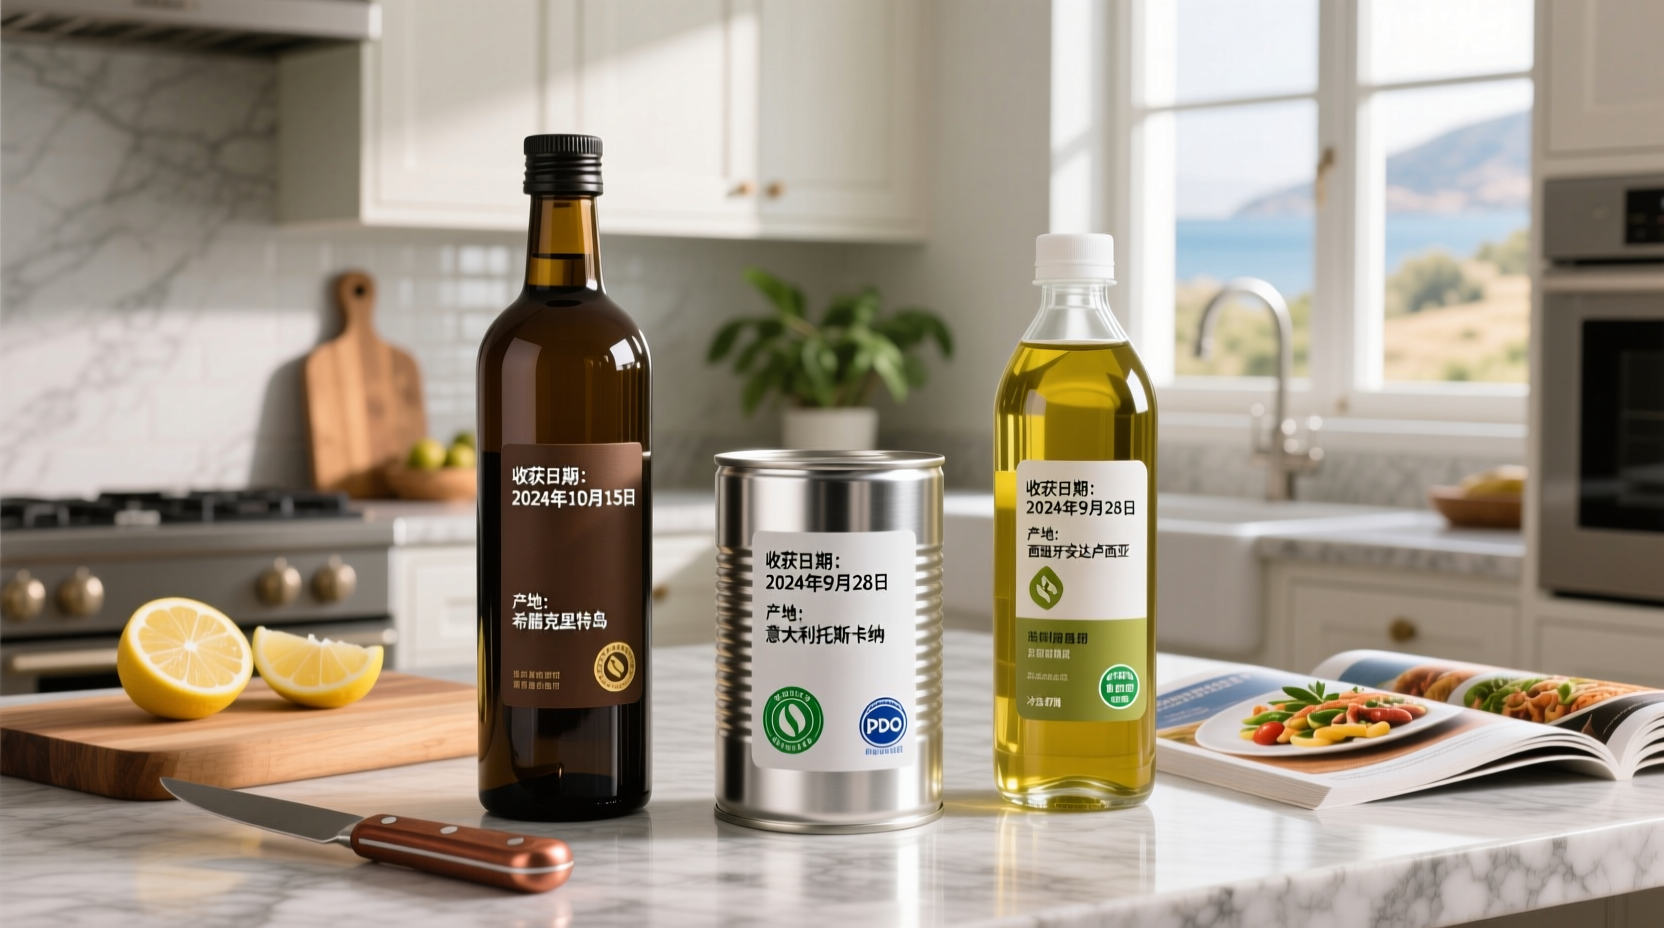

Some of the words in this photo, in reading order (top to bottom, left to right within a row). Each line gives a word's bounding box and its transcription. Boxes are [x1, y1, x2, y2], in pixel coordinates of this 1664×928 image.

[512, 489, 635, 508] 2024年10月15日
[1026, 500, 1135, 516] 2024年9月28日
[765, 573, 888, 592] 2024年9月28日
[867, 717, 902, 734] PDO
